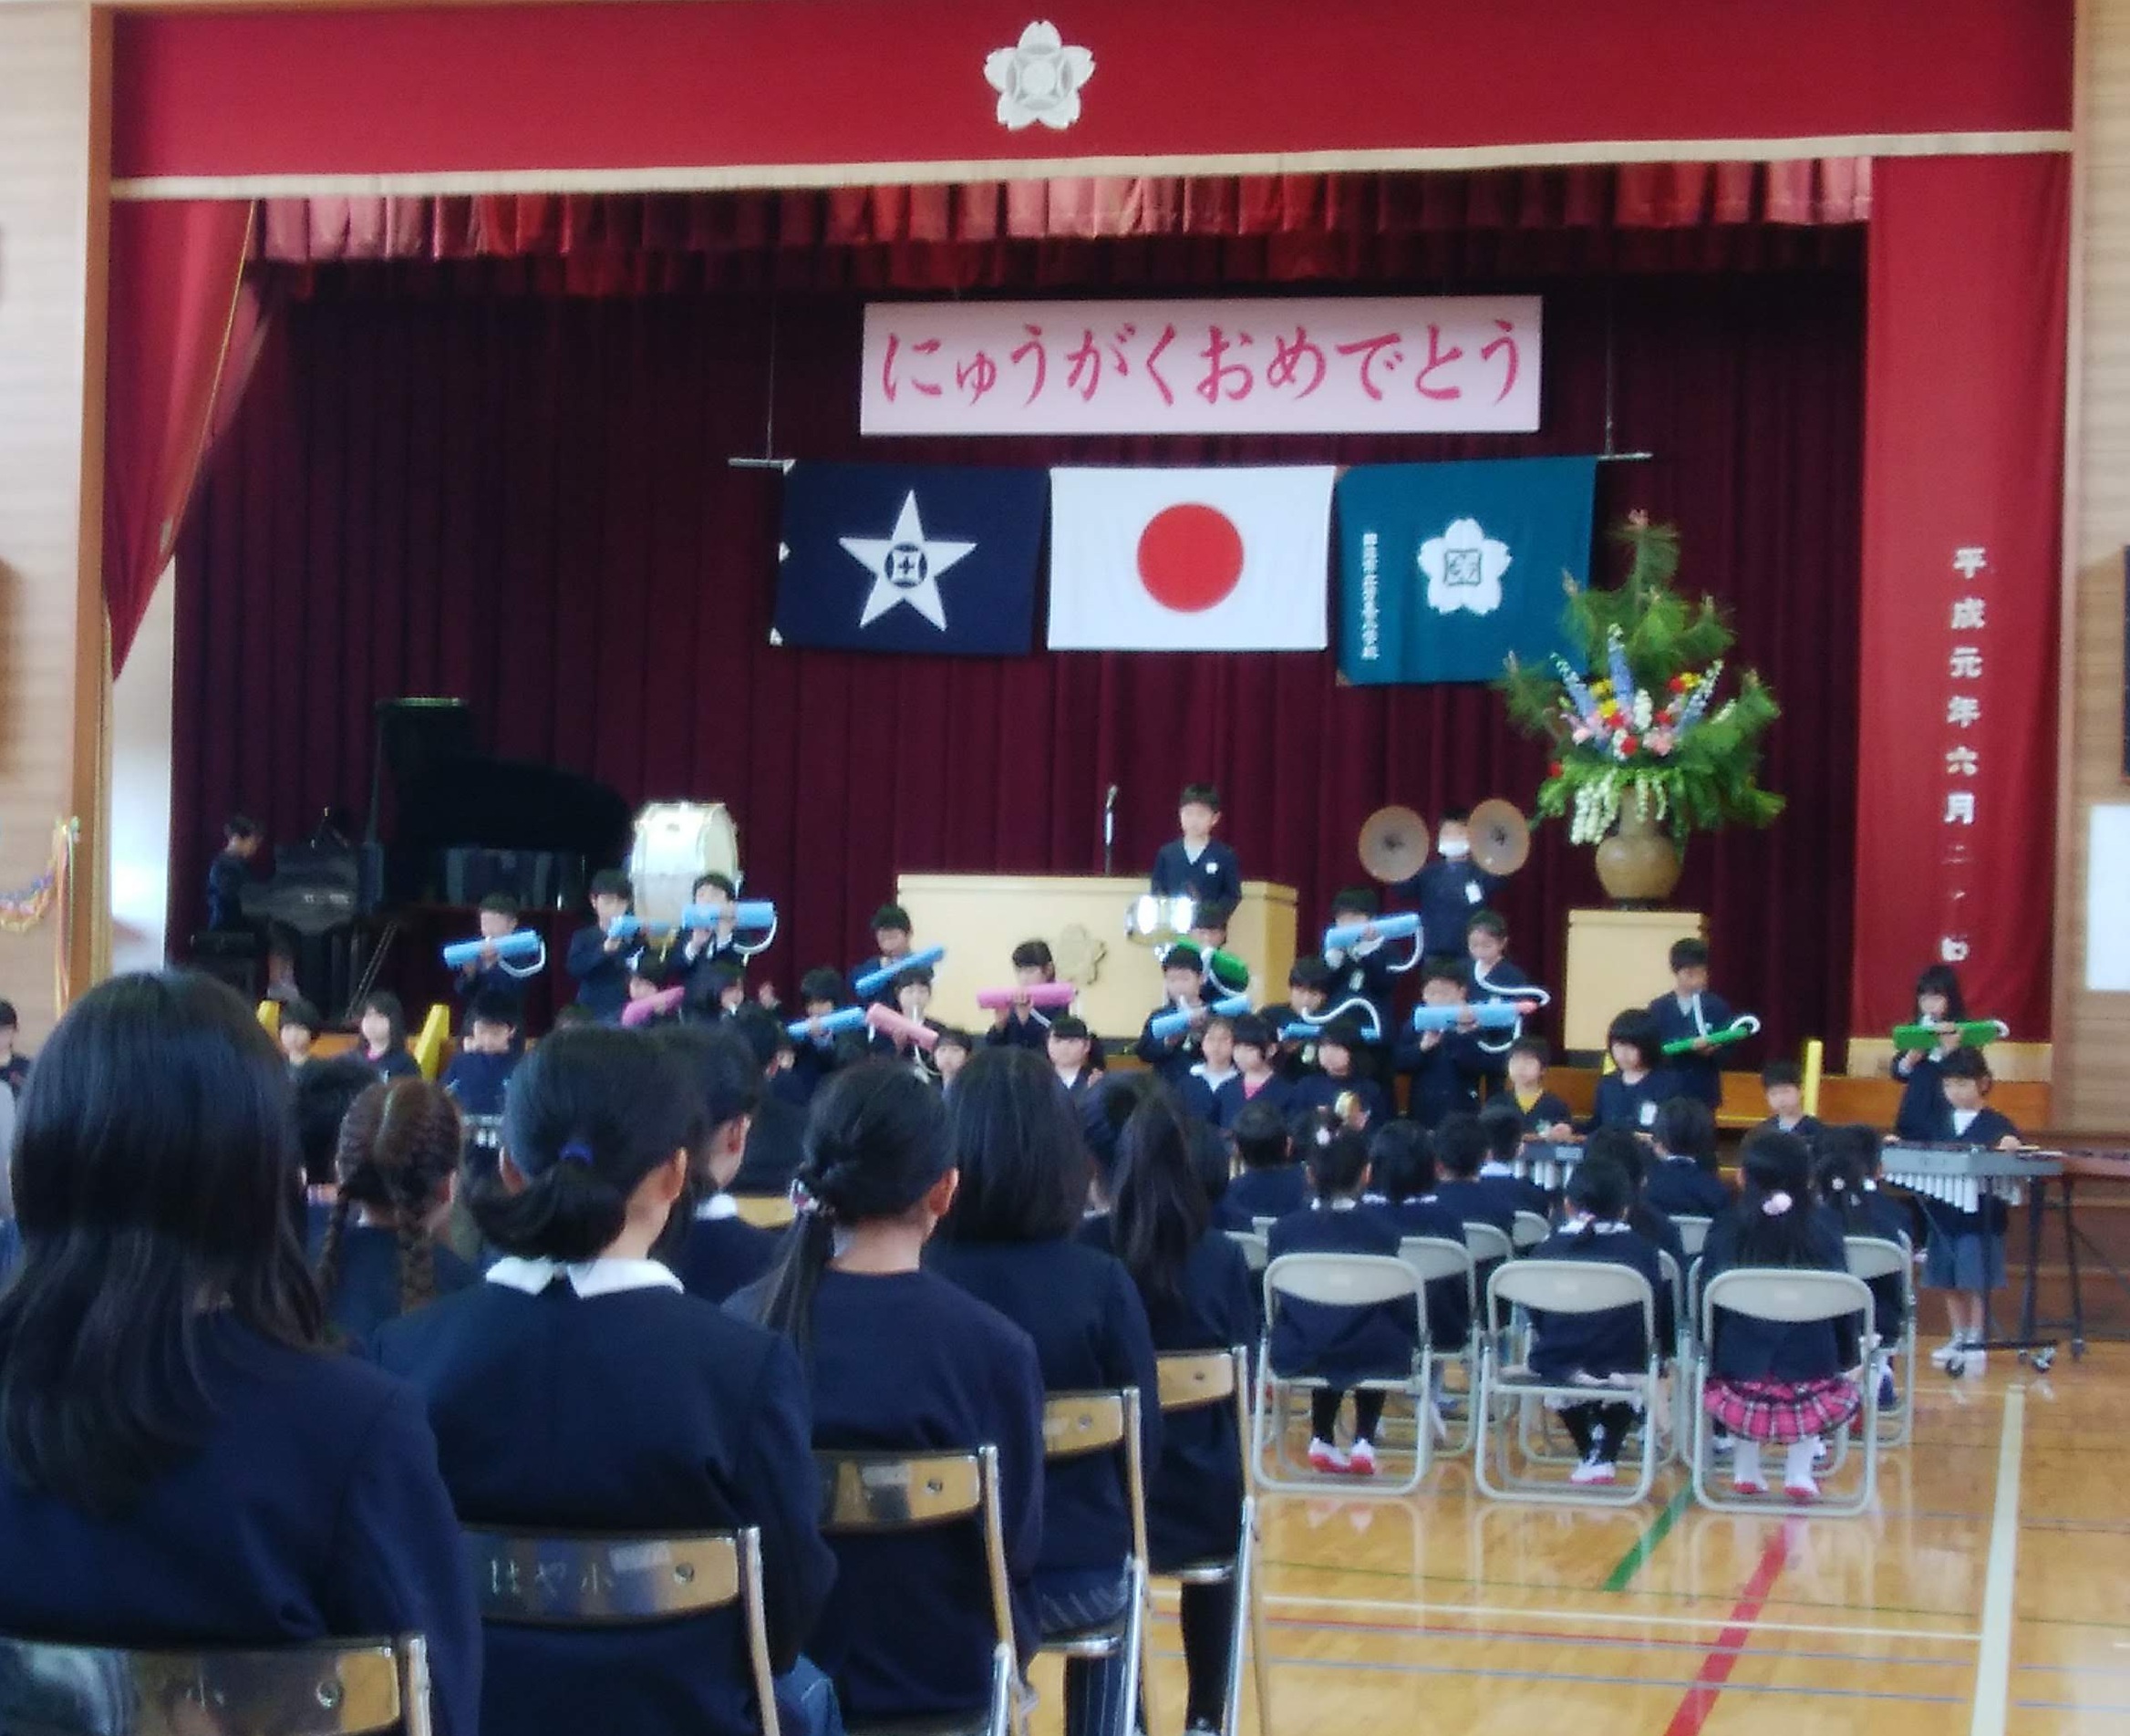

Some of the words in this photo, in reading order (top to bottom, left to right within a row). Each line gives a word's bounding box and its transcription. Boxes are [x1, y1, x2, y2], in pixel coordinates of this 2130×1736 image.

[883, 318, 1520, 406] にゅうがくおめでとう
